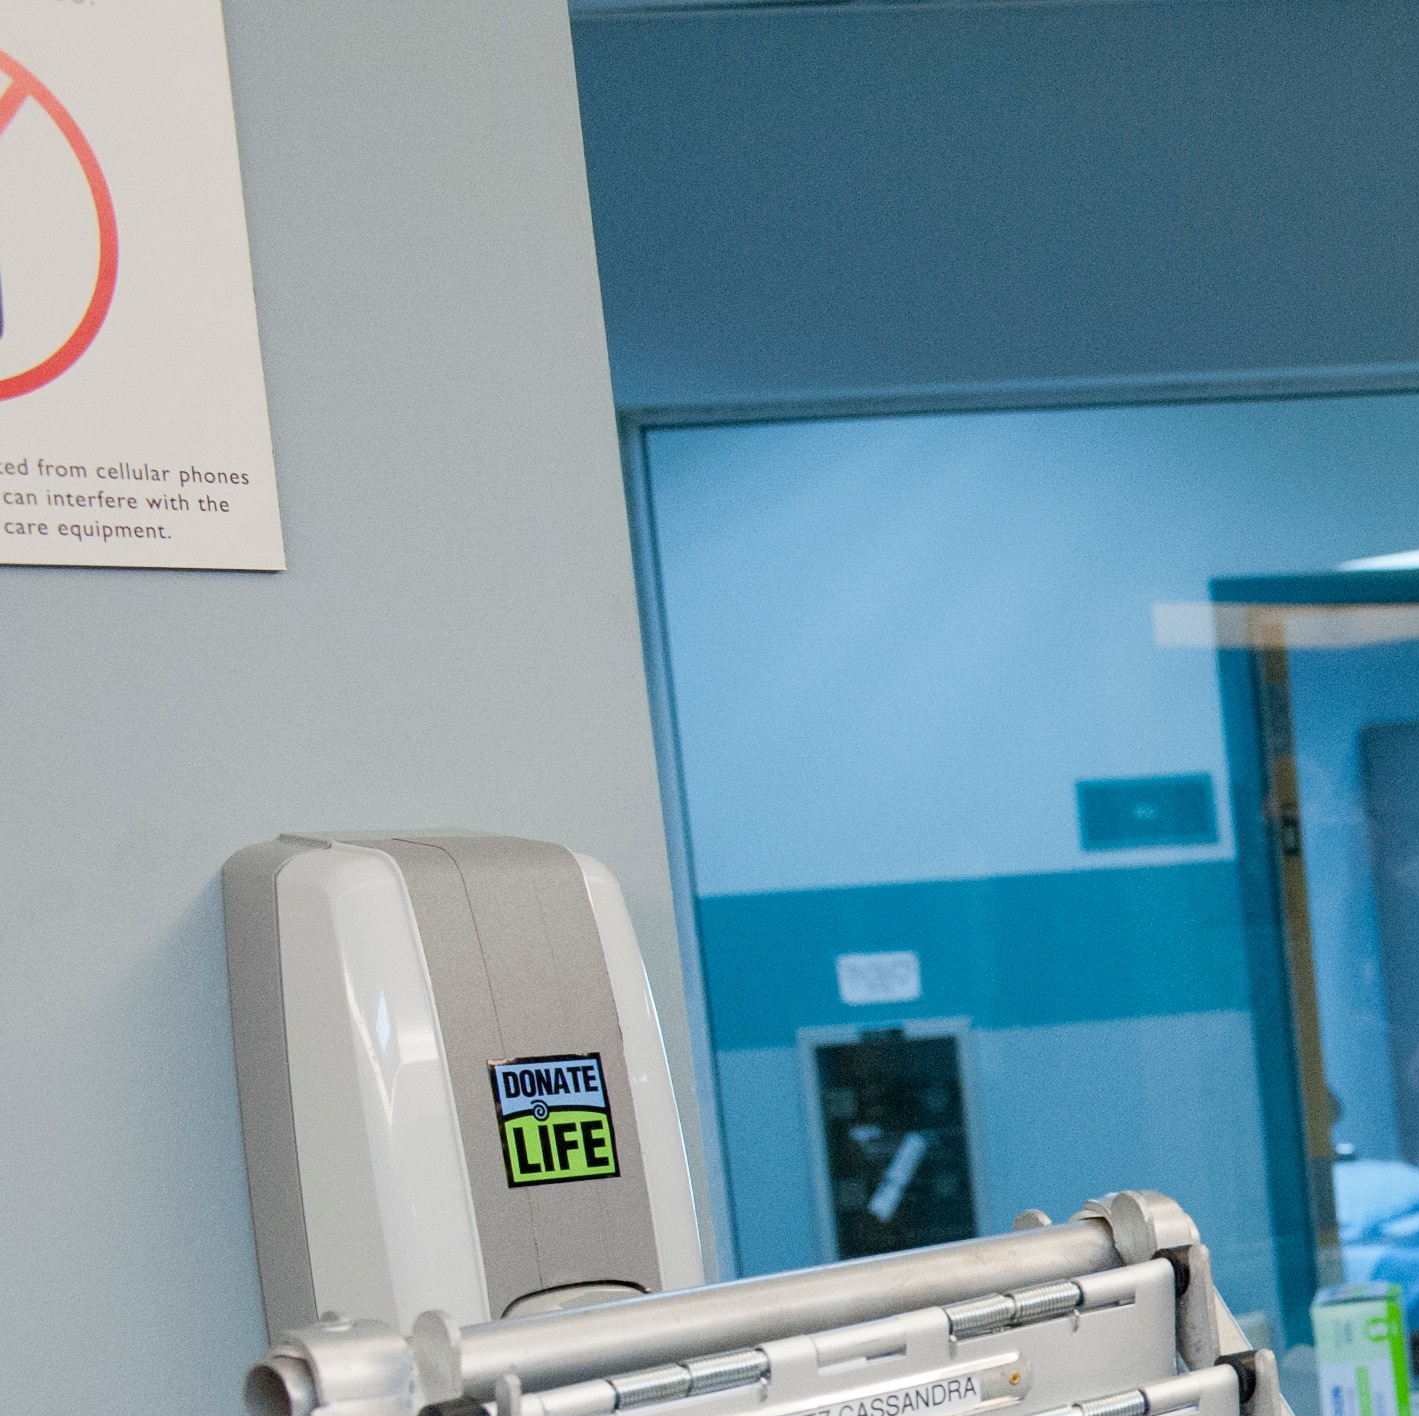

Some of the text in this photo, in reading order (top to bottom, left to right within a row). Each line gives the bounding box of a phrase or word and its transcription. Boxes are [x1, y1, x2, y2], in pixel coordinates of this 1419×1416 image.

[38, 459, 87, 478] from
[96, 463, 170, 482] cellular
[180, 466, 250, 486] phones
[3, 490, 230, 512] can interfere with the
[4, 521, 172, 542] care equipment.
[502, 1065, 599, 1098] DONATE
[513, 1120, 610, 1174] LIFE
